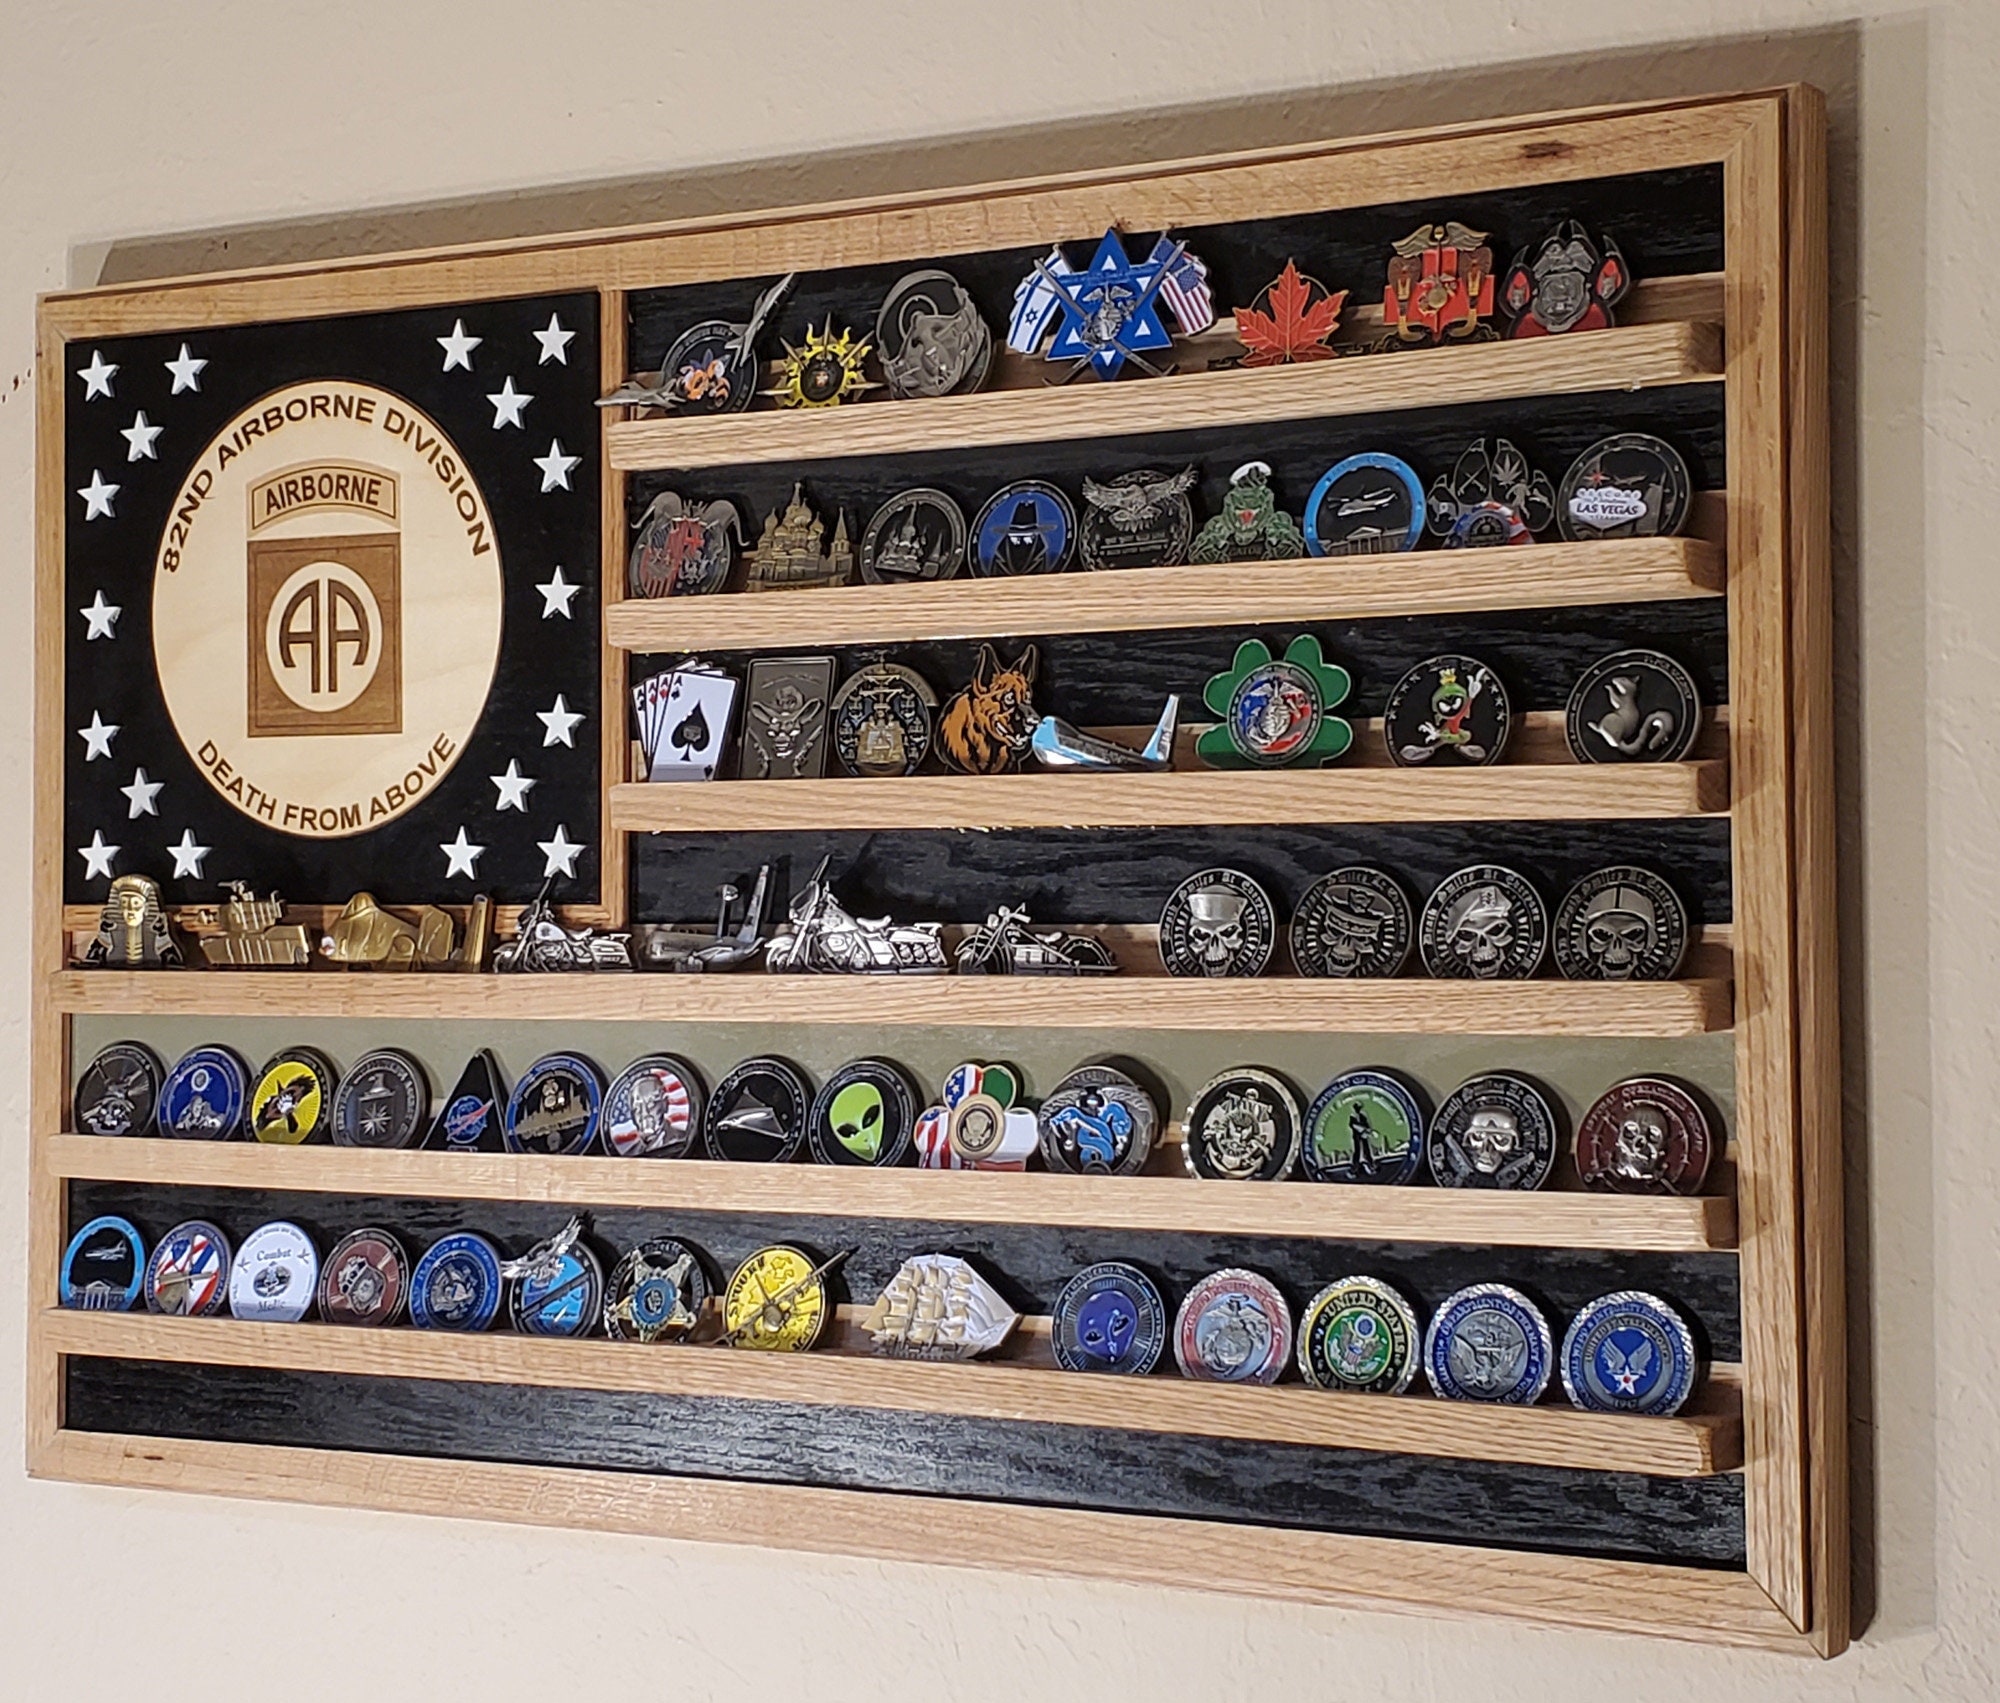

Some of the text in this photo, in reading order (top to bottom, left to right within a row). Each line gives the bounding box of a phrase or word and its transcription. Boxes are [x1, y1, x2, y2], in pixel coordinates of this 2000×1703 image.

[163, 394, 491, 573] 82ND AIRBORNE DIVISION
[264, 473, 382, 515] AIRBORNE
[1576, 503, 1639, 515] LAS VEGAS
[197, 733, 456, 832] DEATH FROM ABOVE
[1324, 1292, 1378, 1318] UNITED
[1377, 1301, 1406, 1354] STATES
[1584, 1323, 1608, 1362] UNITED
